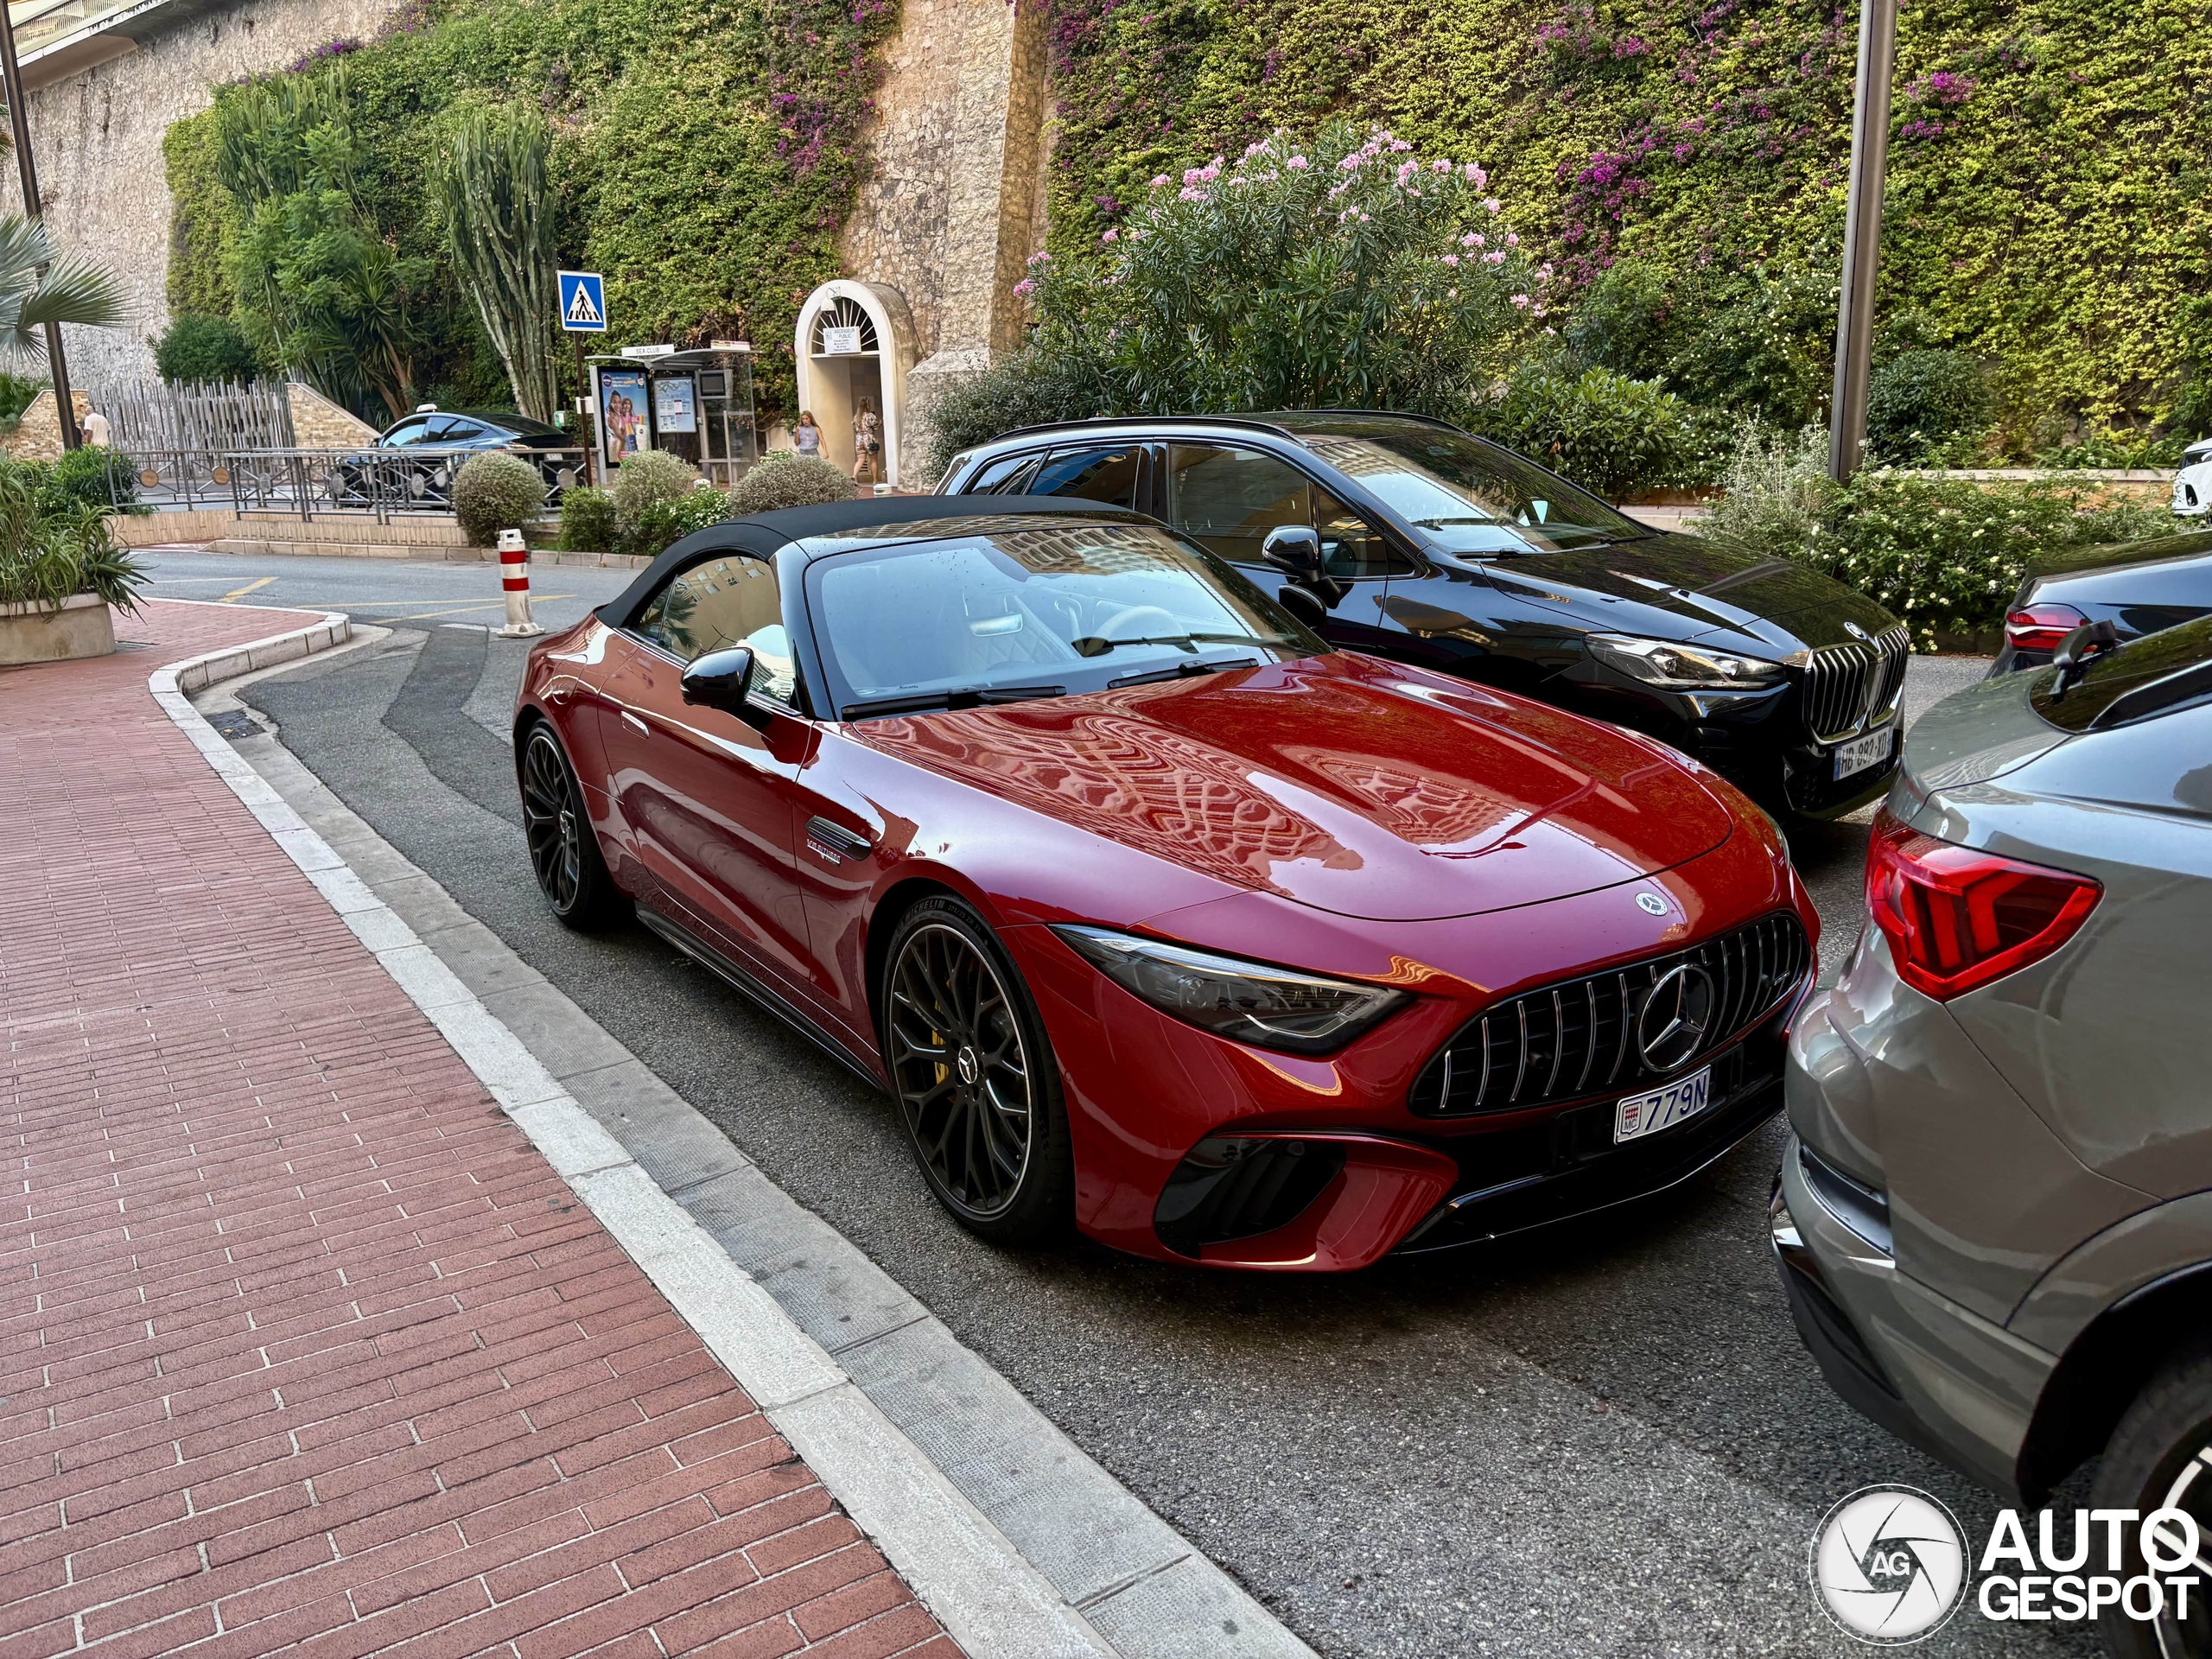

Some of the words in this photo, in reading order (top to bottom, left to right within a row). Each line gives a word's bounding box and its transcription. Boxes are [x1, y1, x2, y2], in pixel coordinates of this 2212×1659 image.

[905, 900, 944, 923] MICHELIN
[1644, 1074, 1707, 1130] 779N
[1624, 1119, 1636, 1130] MC
